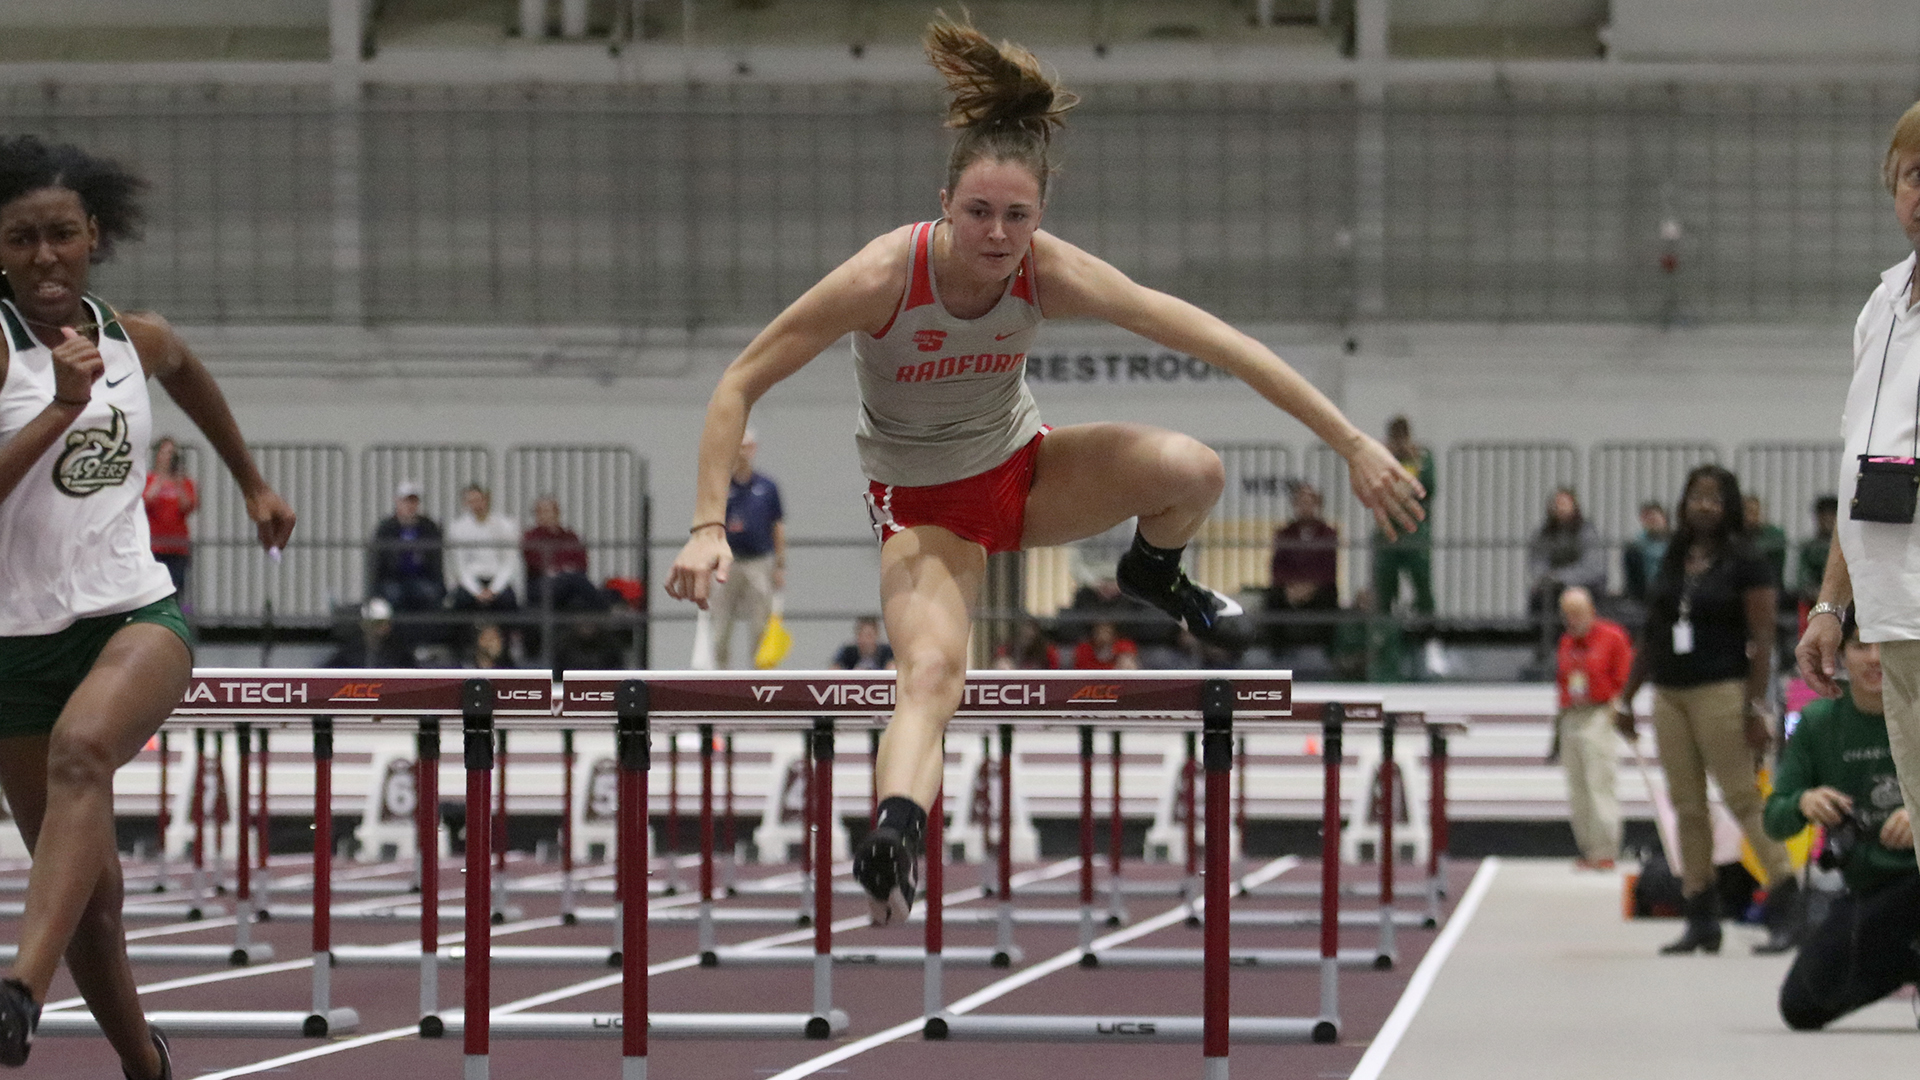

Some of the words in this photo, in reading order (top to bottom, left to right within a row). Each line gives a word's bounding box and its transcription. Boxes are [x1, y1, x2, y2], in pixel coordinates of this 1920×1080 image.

[896, 353, 1026, 382] RADFORD
[1026, 354, 1234, 383] RESTROO
[220, 683, 307, 703] TECH
[333, 683, 383, 698] ACC
[497, 690, 542, 700] UCS
[570, 691, 615, 701] UCS
[751, 686, 784, 702] VT
[807, 684, 896, 705] VIRGI
[963, 684, 1046, 705] TECH
[1072, 684, 1122, 699] ACC
[1236, 690, 1283, 700] UCS
[386, 772, 417, 816] 6
[1097, 1023, 1156, 1035] UCS
